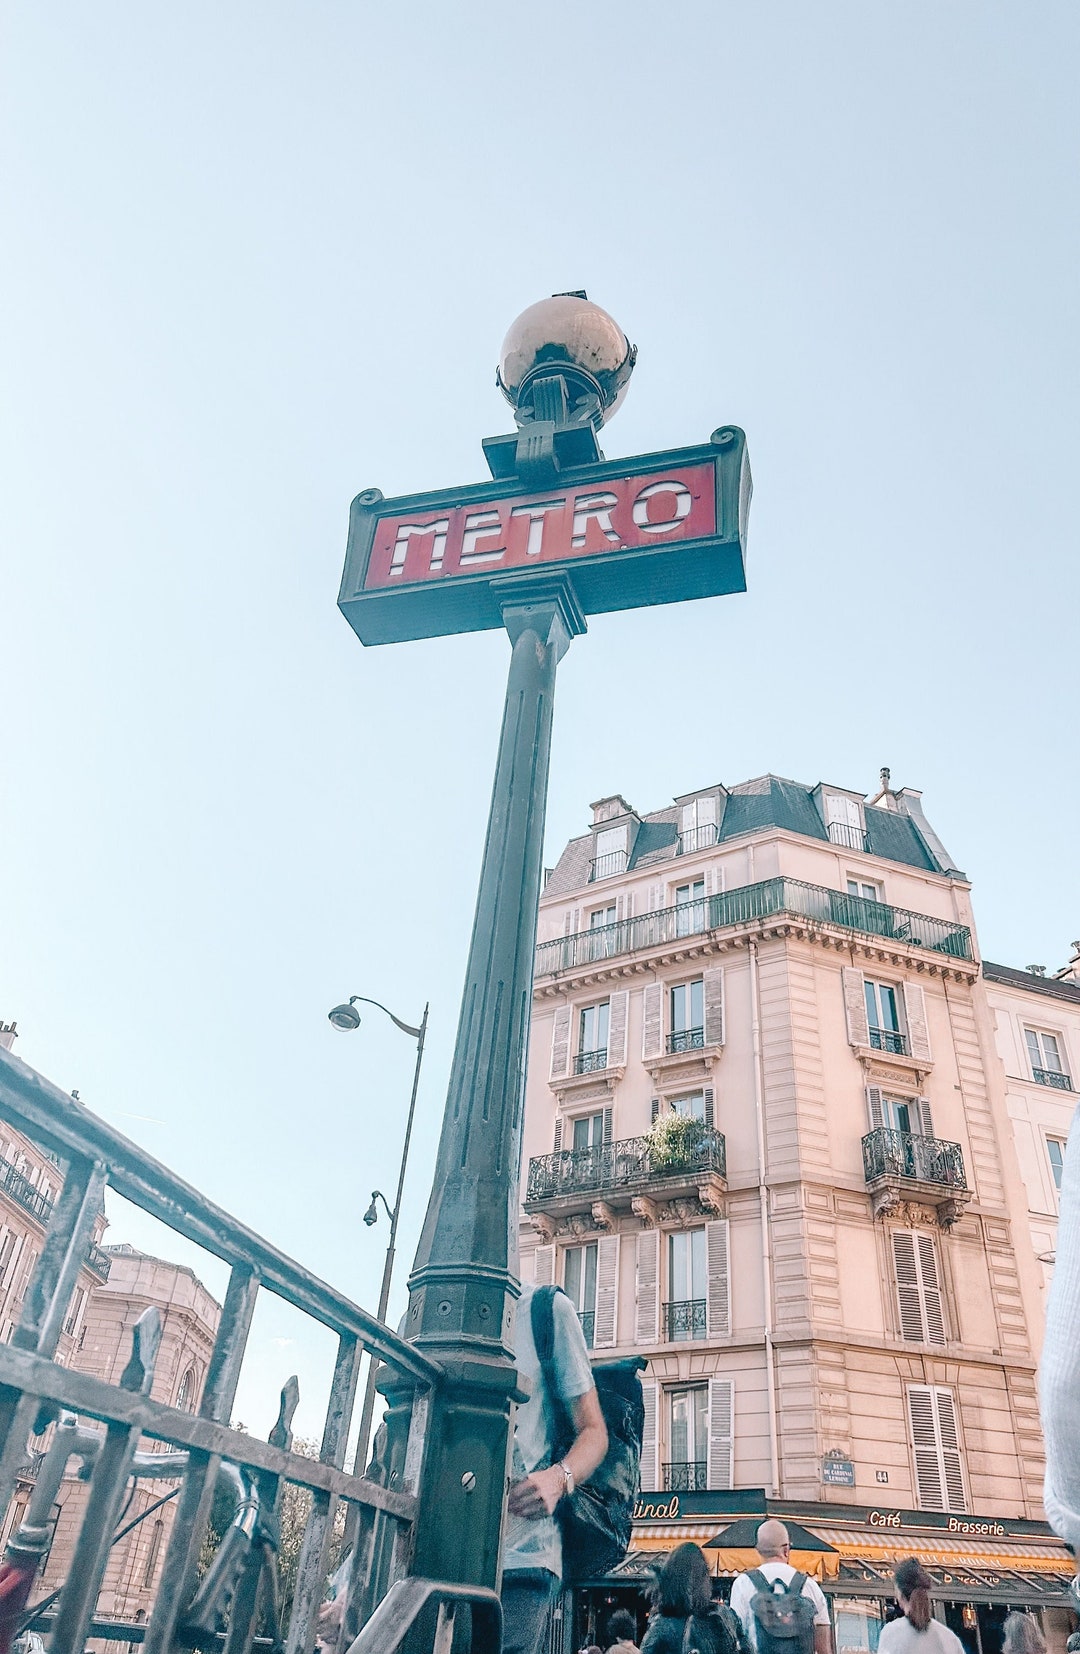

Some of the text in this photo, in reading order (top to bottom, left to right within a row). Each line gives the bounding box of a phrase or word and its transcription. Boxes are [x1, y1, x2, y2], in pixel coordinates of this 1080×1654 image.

[388, 480, 693, 576] METRO
[831, 1469, 853, 1477] CARDINAL
[877, 1471, 888, 1482] 44
[869, 1510, 1005, 1536] Café Brasserie
